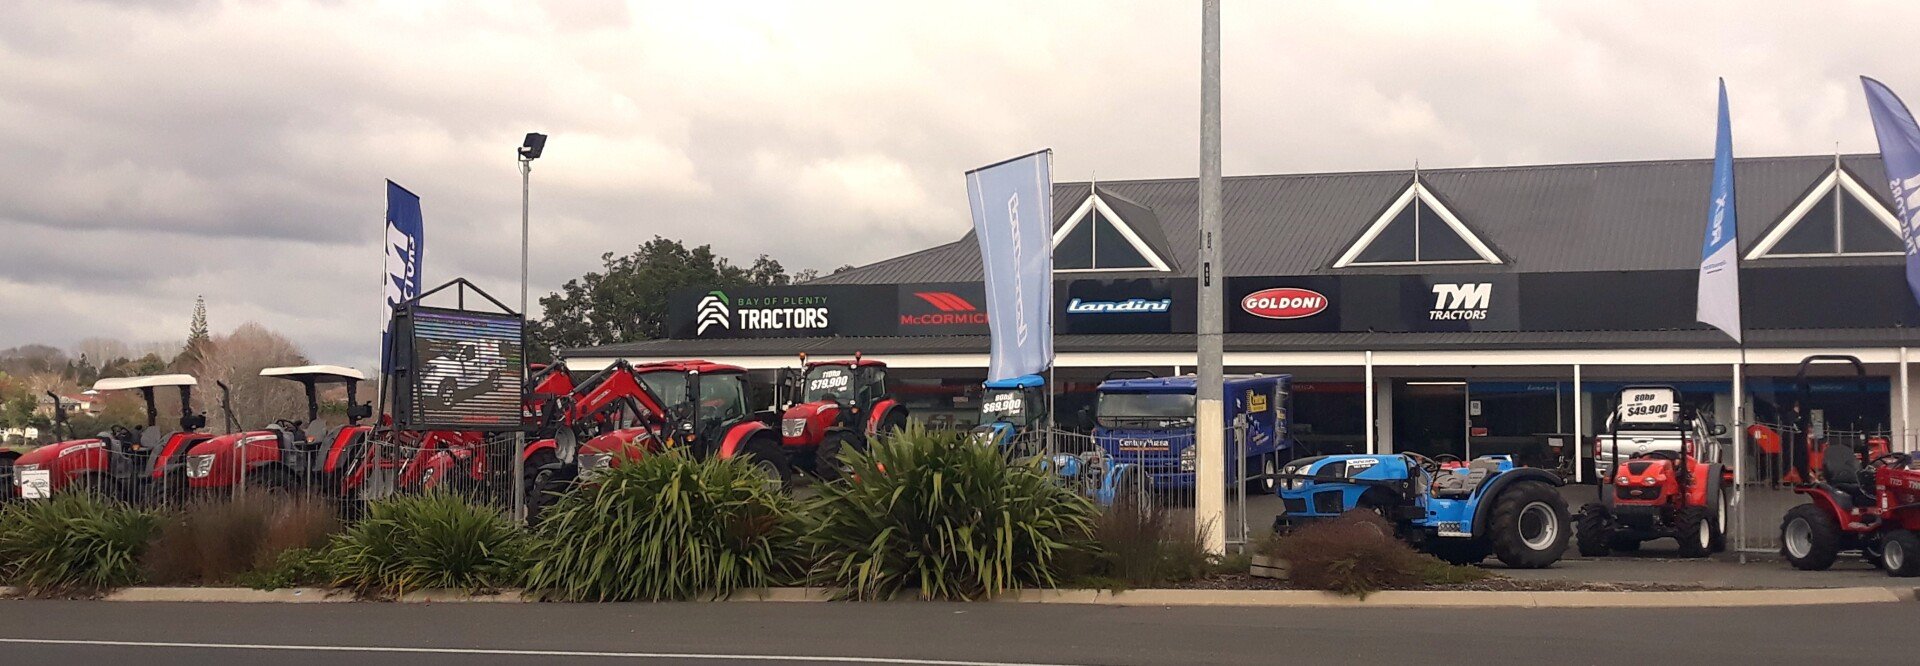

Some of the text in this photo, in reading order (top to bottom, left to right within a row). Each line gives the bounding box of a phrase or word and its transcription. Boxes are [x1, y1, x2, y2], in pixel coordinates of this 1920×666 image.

[738, 296, 828, 306] BAY OF PLENTY
[1246, 297, 1322, 309] GOLDONI
[1432, 283, 1493, 310] TYM
[1067, 298, 1171, 313] Landini
[738, 307, 828, 330] TRACTORS
[1429, 310, 1488, 320] TRACTORS
